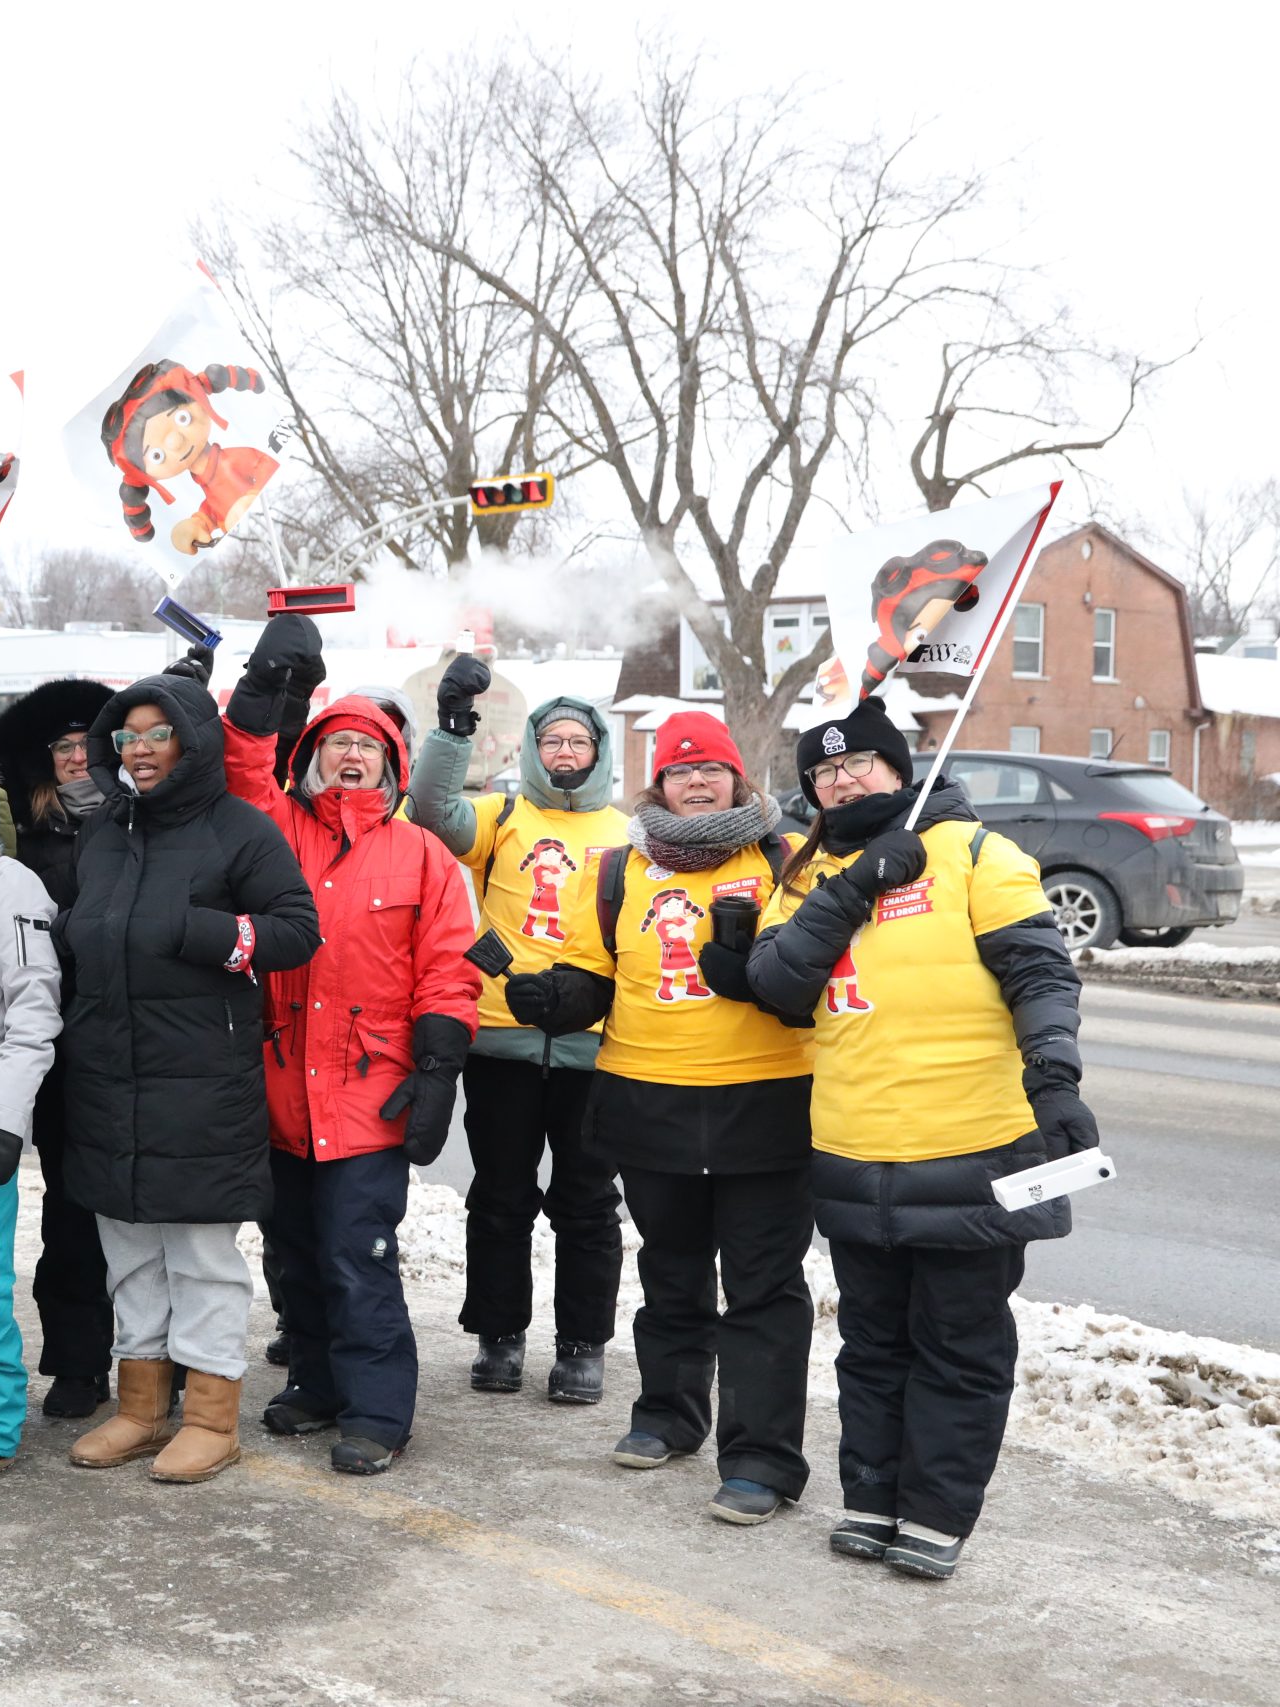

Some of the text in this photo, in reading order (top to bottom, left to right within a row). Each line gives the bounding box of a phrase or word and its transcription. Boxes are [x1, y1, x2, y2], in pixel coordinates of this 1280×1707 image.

[953, 657, 970, 665] CSN
[826, 743, 844, 753] CSN
[716, 879, 757, 892] PARCE QUE
[885, 880, 929, 895] PARCE QUE
[882, 892, 922, 906] CHACUNE
[882, 911, 889, 919] Y
[888, 910, 895, 919] A
